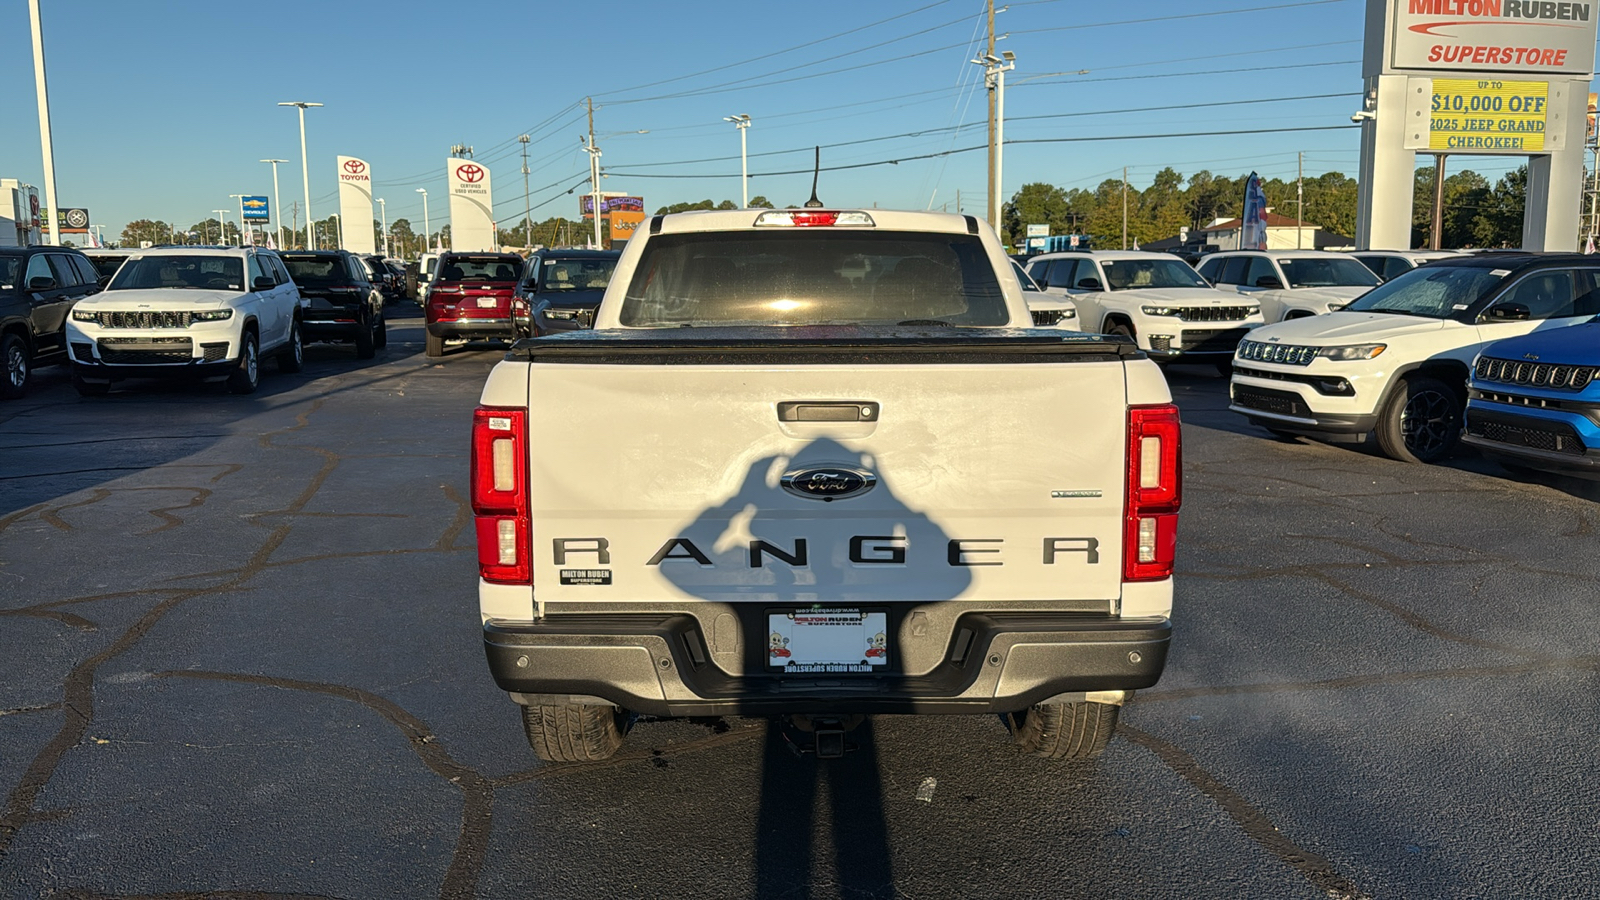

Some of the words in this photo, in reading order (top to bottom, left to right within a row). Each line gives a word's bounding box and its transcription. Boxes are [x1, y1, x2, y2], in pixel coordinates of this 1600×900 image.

[1408, 0, 1500, 17] MILTON
[1503, 0, 1590, 21] RUBEN
[1428, 45, 1567, 66] SUPERSTORE
[1478, 81, 1489, 89] UP
[1491, 81, 1503, 89] TO
[1431, 93, 1503, 114] $10,000
[1508, 95, 1545, 112] OFF
[1429, 118, 1458, 130] 2025
[1462, 118, 1494, 131] JEEP
[1498, 119, 1545, 132] GRAND
[1447, 136, 1524, 149] CHEROKEE!
[614, 218, 640, 230] Jee
[807, 473, 849, 490] Ford
[553, 536, 1099, 567] RANGER
[562, 570, 587, 578] MILTON
[587, 570, 610, 578] RUBEN
